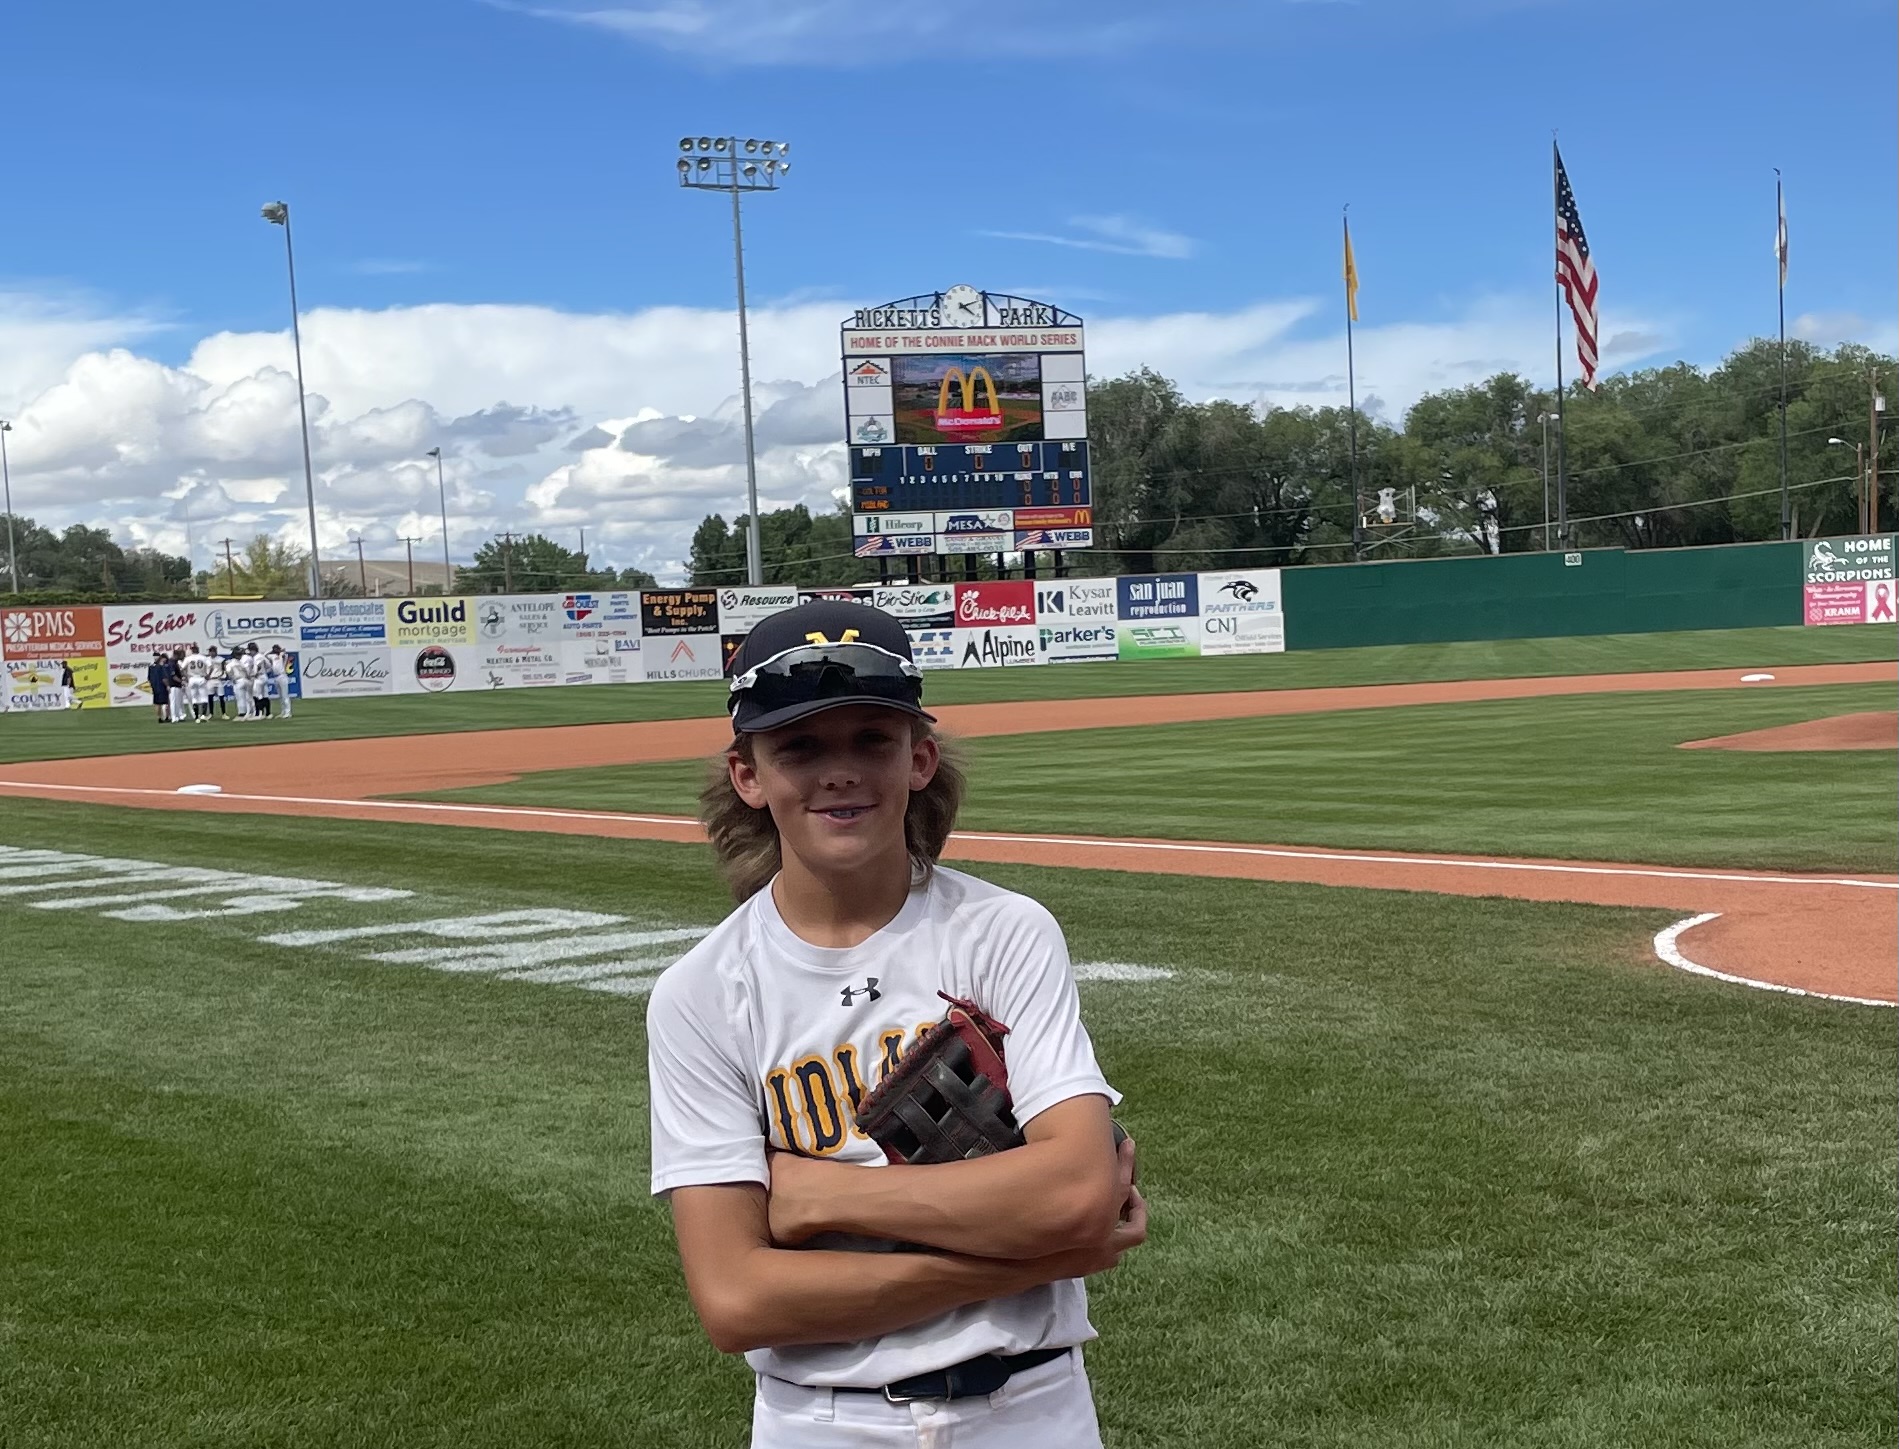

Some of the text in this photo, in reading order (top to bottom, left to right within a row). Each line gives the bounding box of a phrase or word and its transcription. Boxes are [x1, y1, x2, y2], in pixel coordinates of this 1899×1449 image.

[855, 307, 1048, 328] RICKETTS PARK
[850, 333, 1077, 349] HOME OF THE CONNIE MACK WORLD SERIES
[857, 375, 880, 385] NTEC
[862, 448, 881, 457] MPH
[917, 446, 938, 456] BALL
[965, 444, 993, 454] STRIKE
[885, 520, 923, 531] Hilcorp
[948, 520, 981, 531] MESA
[895, 537, 932, 547] WEBB
[1055, 531, 1090, 541] WEBB
[1844, 539, 1891, 553] HOME
[1855, 555, 1889, 565] OF THE
[1807, 568, 1892, 583] SCORPIONS
[1069, 585, 1112, 603] Kysar
[1130, 578, 1186, 604] san juan
[642, 593, 716, 606] Energy Pump
[740, 594, 794, 606] Resource
[322, 600, 385, 619] Eye Associates
[398, 600, 466, 624] Guild
[511, 603, 556, 612] ANTELOPE
[653, 604, 707, 617] & Supply,
[959, 597, 1031, 623] Chick-fil-A
[1069, 602, 1114, 617] Leavitt
[1130, 602, 1187, 618] reproduction
[1205, 601, 1275, 614] PANTHERS
[1824, 607, 1860, 617] XRANM
[33, 611, 75, 637] PMS
[227, 617, 293, 629] LOGOS
[671, 618, 689, 626] Inc.
[1205, 617, 1238, 635] CNJ
[398, 625, 467, 637] mortgage
[1040, 625, 1115, 652] Parker's
[131, 643, 198, 653] Restaurant
[983, 629, 1035, 667] Alpine
[7, 660, 62, 673] SAN JUAN
[303, 656, 390, 679] Desert View
[647, 668, 721, 680] HILLS CHURCH
[11, 692, 63, 703] COUNTY
